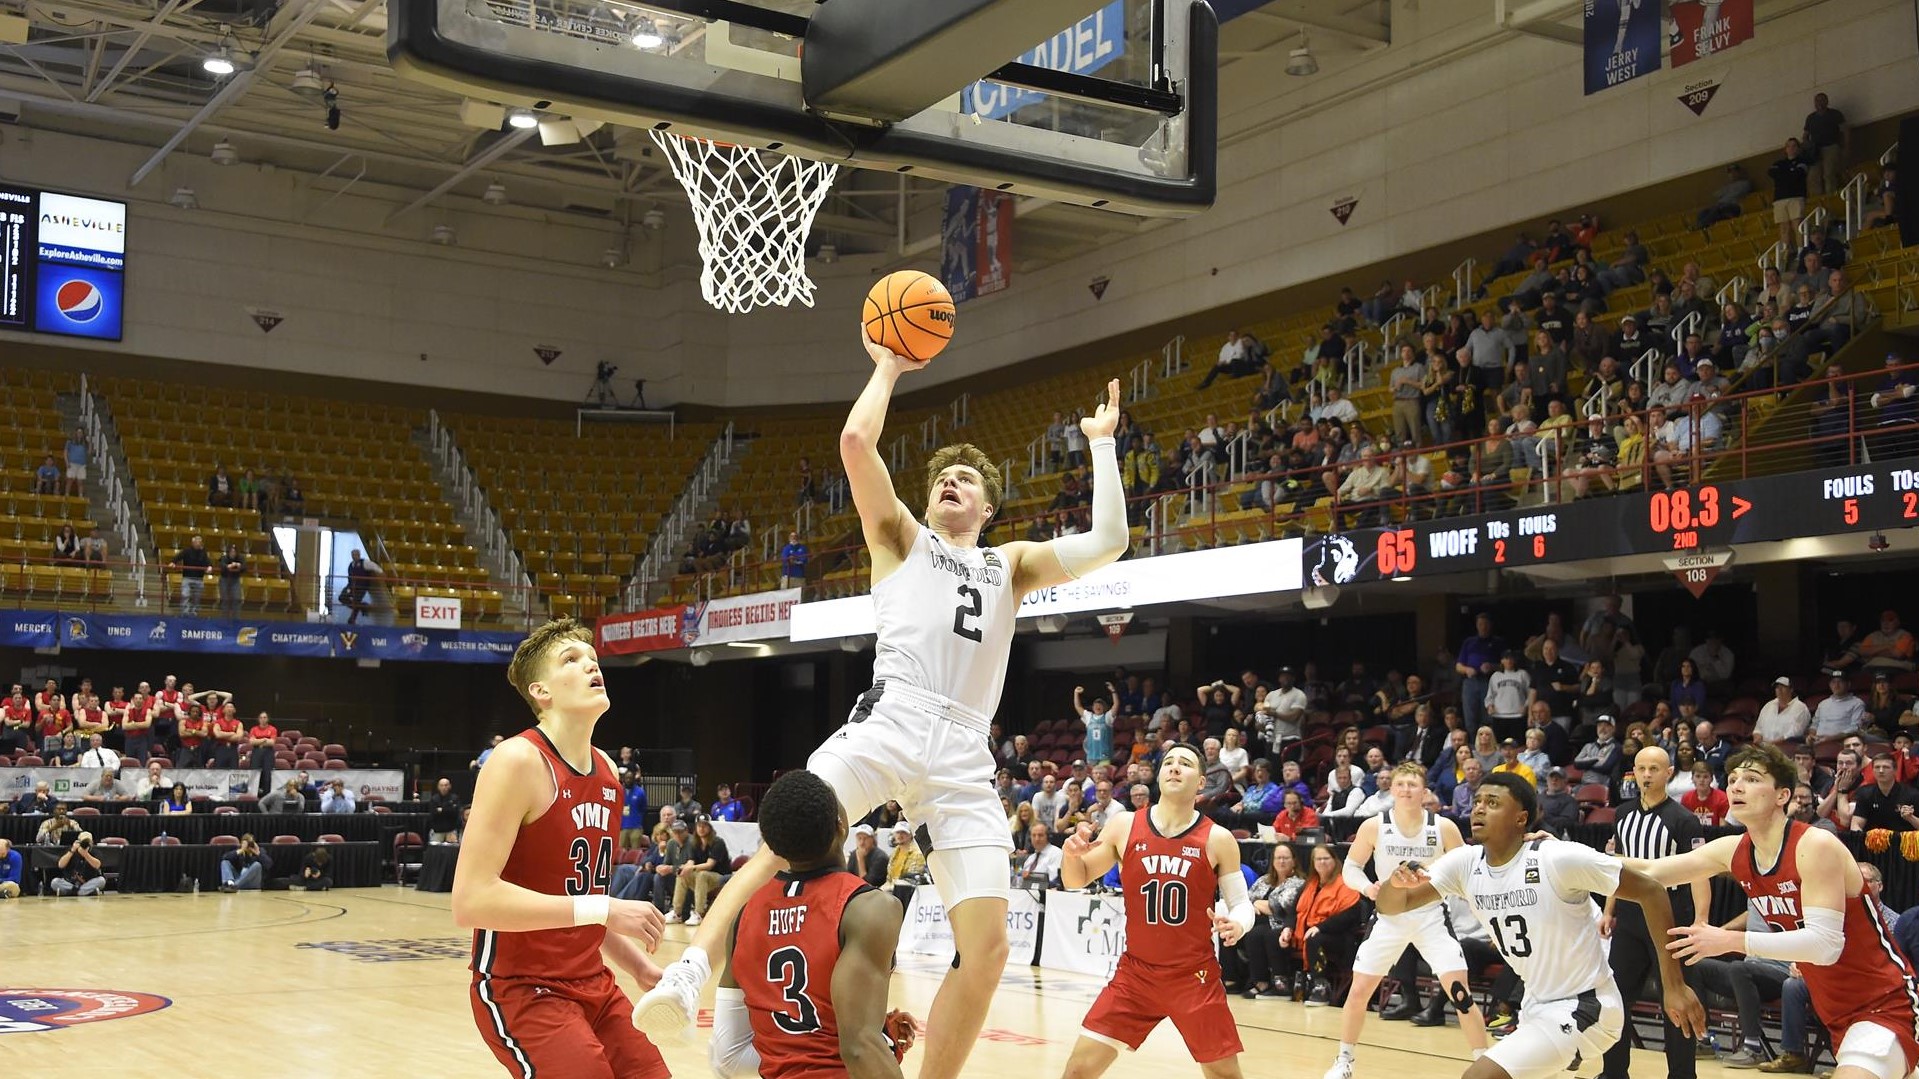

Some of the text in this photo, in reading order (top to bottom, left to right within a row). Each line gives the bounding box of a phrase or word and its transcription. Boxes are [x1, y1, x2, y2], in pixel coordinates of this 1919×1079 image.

[1693, 16, 1731, 41] FRANK
[1695, 32, 1731, 57] SELVY
[1605, 47, 1639, 71] JERRY
[1606, 64, 1638, 86] WEST
[1684, 78, 1714, 93] Section
[1688, 90, 1709, 106] 209
[41, 213, 123, 233] ASHEVILLE
[39, 246, 123, 266] ExploreAsheville.com
[1824, 469, 1919, 499] FOULS TOs
[1650, 486, 1719, 533] 08.3
[1844, 492, 1918, 525] 5 2
[1377, 514, 1556, 575] 65 WOFF TOs FOULS
[1495, 535, 1546, 563] 2 6
[1674, 531, 1698, 549] 2ND
[1678, 555, 1714, 567] SECTION
[1685, 568, 1707, 582] 108
[420, 605, 458, 620] EXIT
[746, 602, 775, 626] BEGINS
[953, 584, 983, 643] 2
[15, 622, 222, 641] MERCER UNCG SAMFORD
[271, 632, 387, 647] CHATTANOOGA VMI
[441, 640, 513, 652] WESTERN CAROLINA
[571, 802, 611, 831] VMI
[1386, 845, 1434, 857] WOFFORD
[565, 836, 613, 896] 34
[1141, 855, 1192, 878] VMI
[1140, 878, 1188, 926] 10
[1474, 888, 1537, 911] WOFFORD
[1751, 894, 1798, 917] VMI
[768, 905, 807, 935] HUFF
[1489, 914, 1532, 957] 13
[766, 945, 822, 1034] 3
